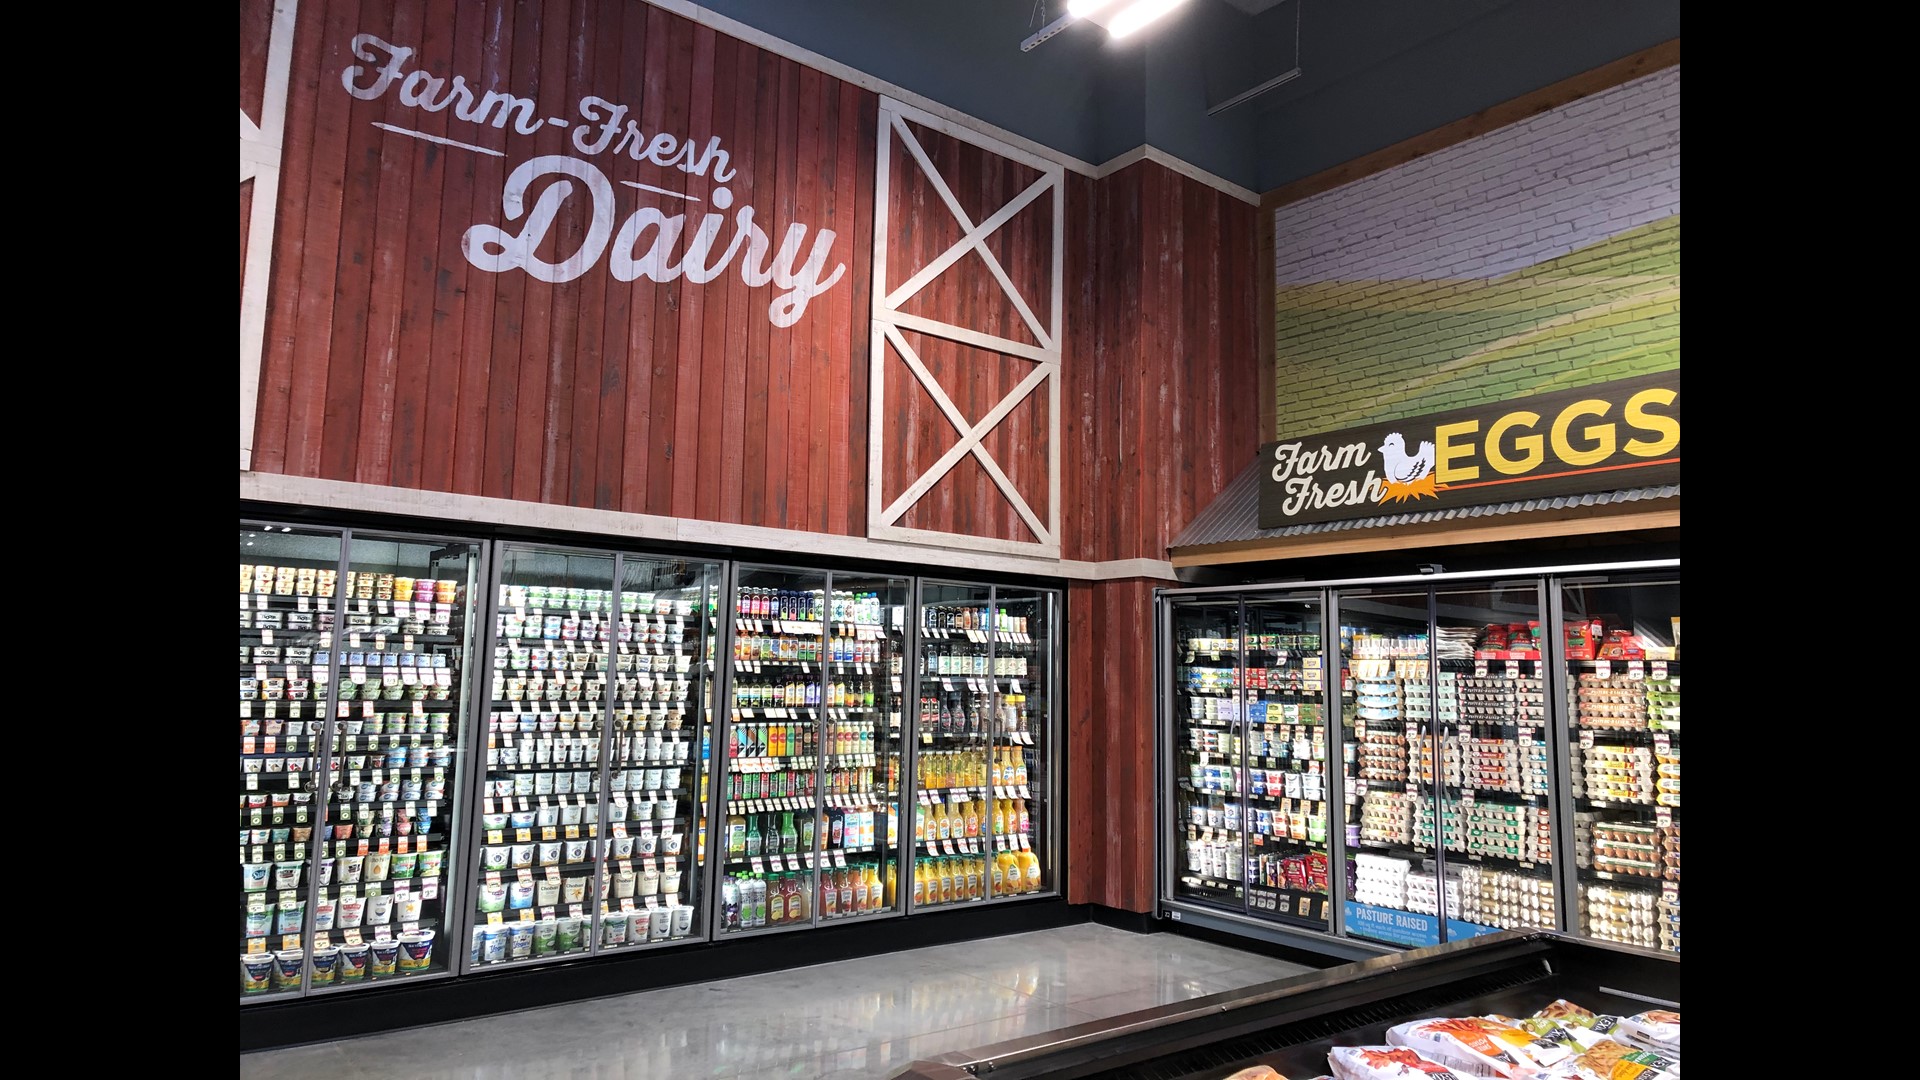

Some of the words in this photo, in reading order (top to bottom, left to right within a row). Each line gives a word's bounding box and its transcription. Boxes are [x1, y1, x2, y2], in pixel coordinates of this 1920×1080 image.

[341, 33, 737, 184] Farm-Fresh
[461, 154, 847, 328] Dairy
[1271, 440, 1371, 482] Farm
[1435, 387, 1680, 484] EGGS
[1281, 469, 1389, 517] Fresh
[1356, 907, 1394, 926] PASTURE
[1396, 915, 1428, 932] RAISED
